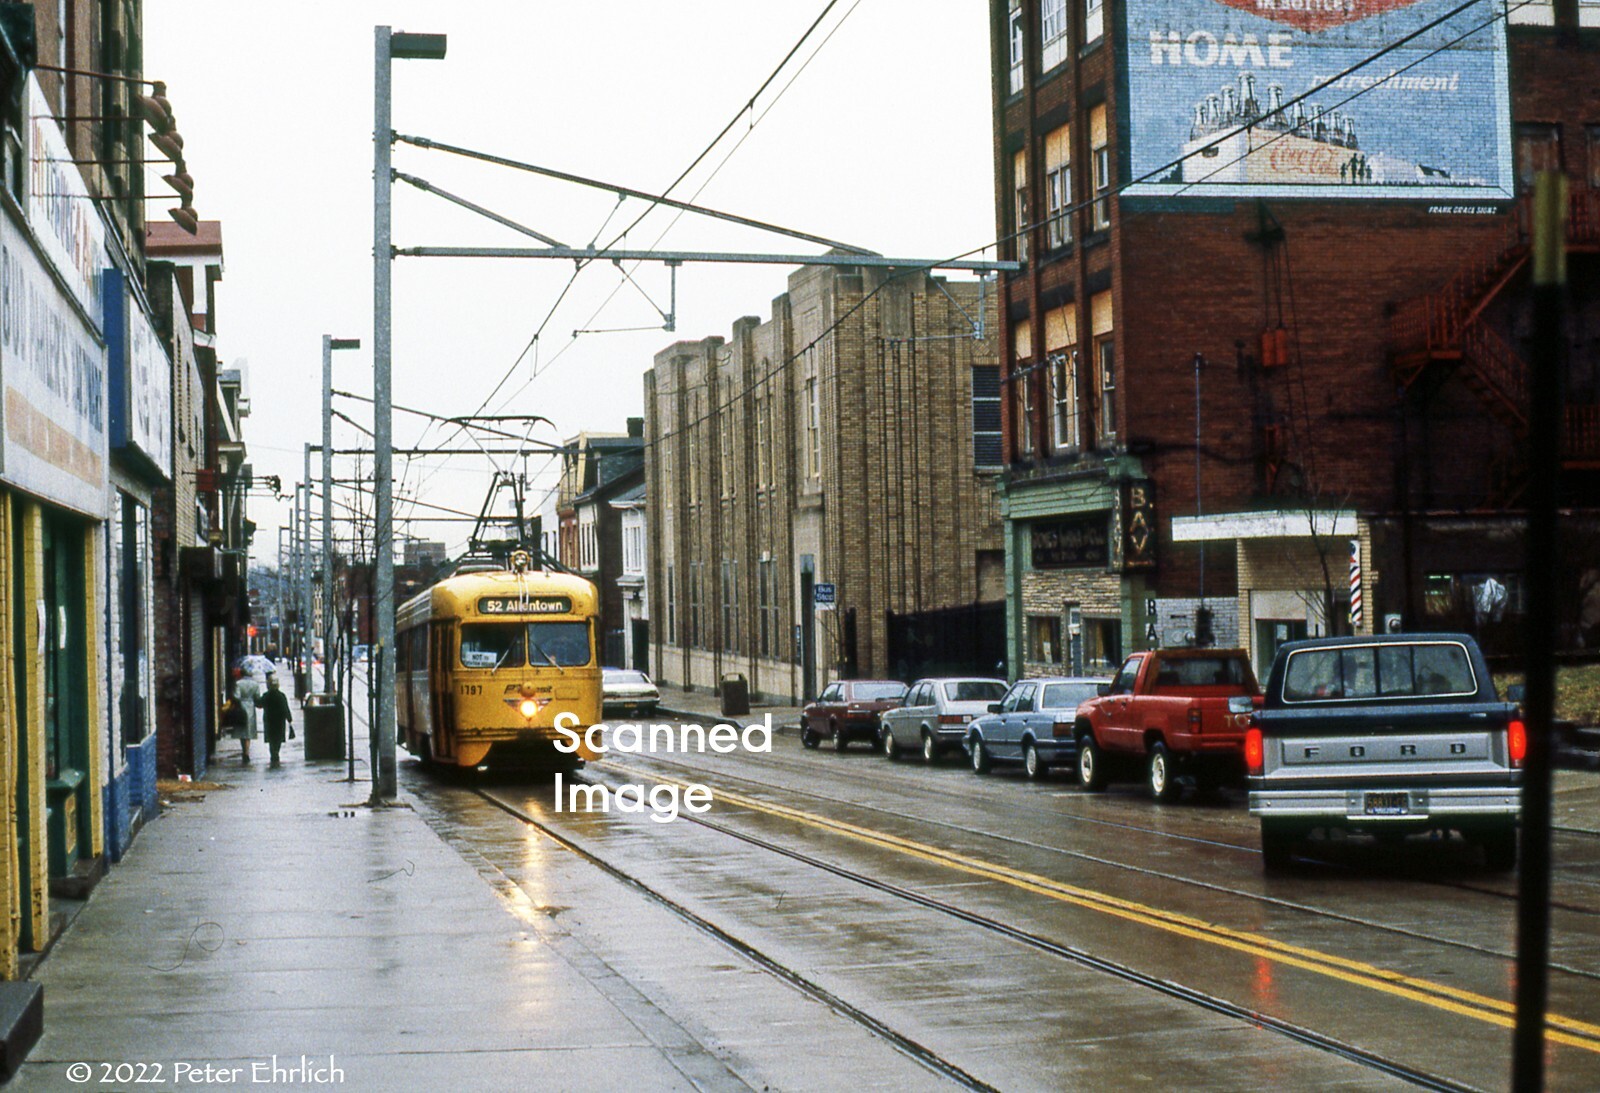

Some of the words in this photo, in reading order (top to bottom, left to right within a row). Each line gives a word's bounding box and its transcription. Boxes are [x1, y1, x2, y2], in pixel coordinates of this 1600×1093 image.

[1149, 30, 1294, 67] HOME
[818, 585, 832, 593] Bus
[816, 593, 834, 601] Stop
[487, 600, 503, 612] 52
[506, 600, 563, 612] Allentown
[460, 685, 483, 695] 1797
[1304, 742, 1466, 758] FORD
